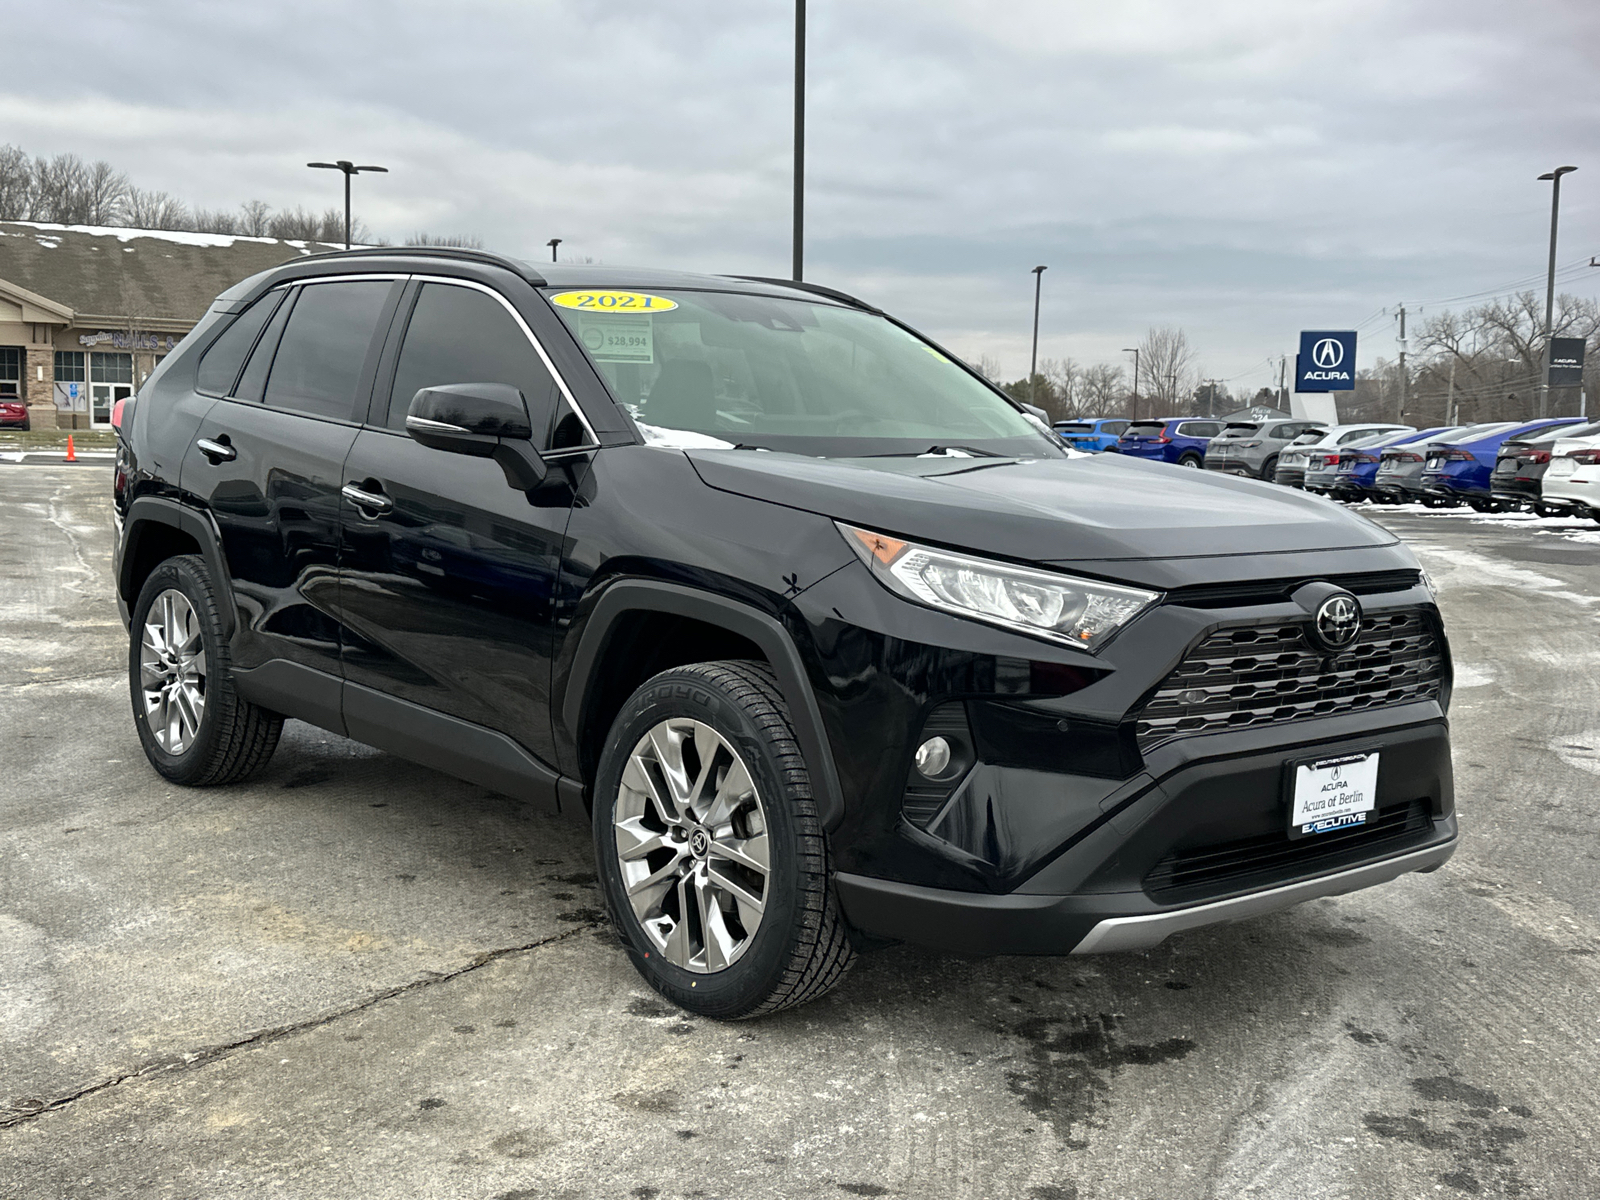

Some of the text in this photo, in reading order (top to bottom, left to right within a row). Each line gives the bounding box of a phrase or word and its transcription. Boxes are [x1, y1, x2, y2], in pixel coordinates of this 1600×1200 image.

[577, 295, 655, 309] 2021
[113, 332, 159, 350] NAILS
[607, 336, 647, 348] $28,994
[1304, 371, 1350, 380] ACURA
[1320, 781, 1348, 793] ACURA
[1302, 800, 1326, 813] Acura
[1327, 796, 1337, 808] of
[1338, 790, 1364, 806] Berlin
[1302, 812, 1366, 834] EXECUTIVE
